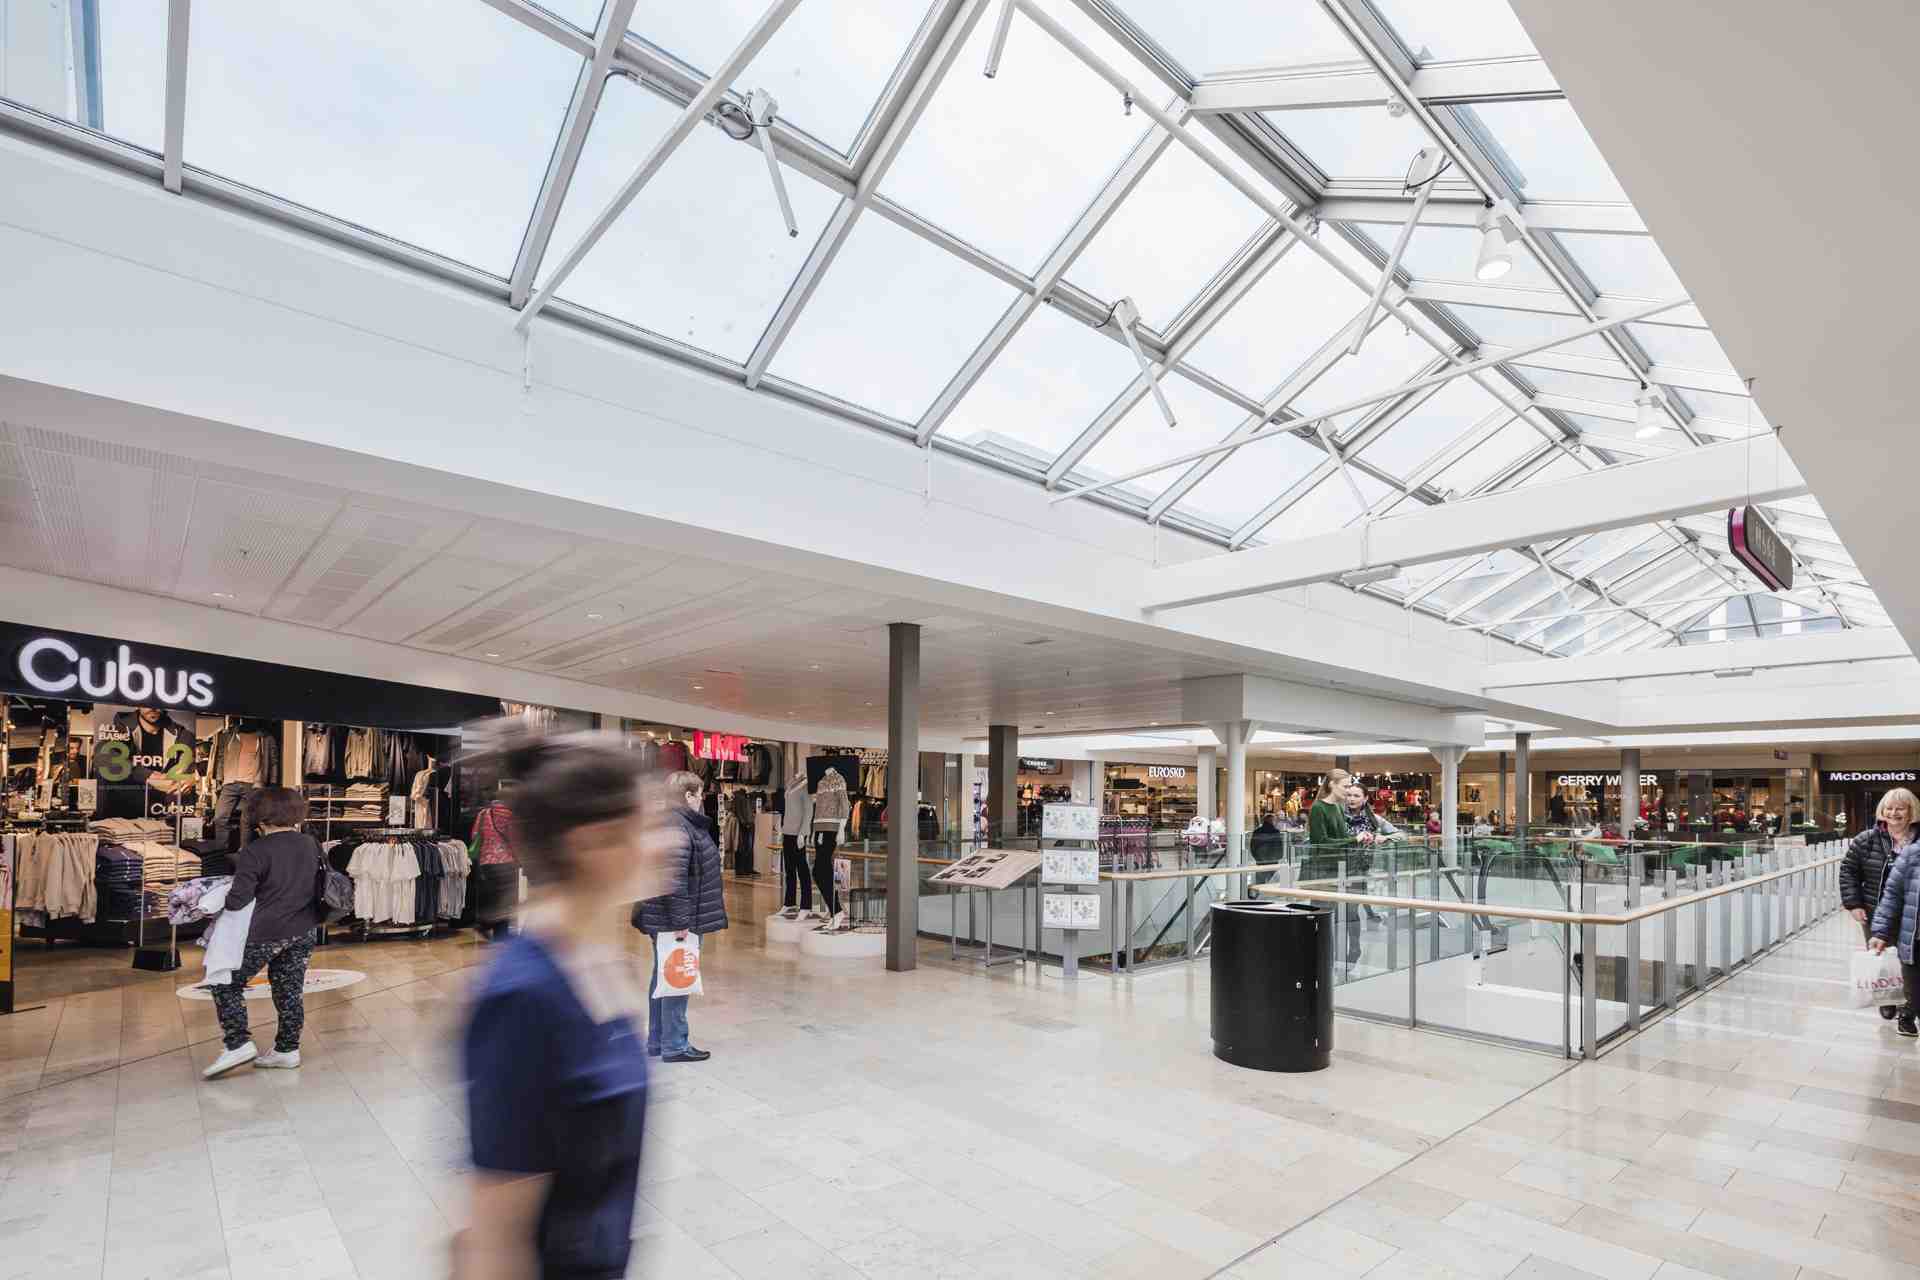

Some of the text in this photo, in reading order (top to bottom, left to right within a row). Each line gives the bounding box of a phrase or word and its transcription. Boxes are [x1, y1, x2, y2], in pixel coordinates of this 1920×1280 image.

[18, 637, 214, 707] Cubus
[99, 724, 118, 732] ALL
[99, 741, 193, 782] 3 FOR 2
[1148, 766, 1185, 778] EUROSKO
[1829, 771, 1916, 781] McDonald's
[1558, 774, 1658, 786] GERRY WER
[150, 802, 195, 815] Cubus
